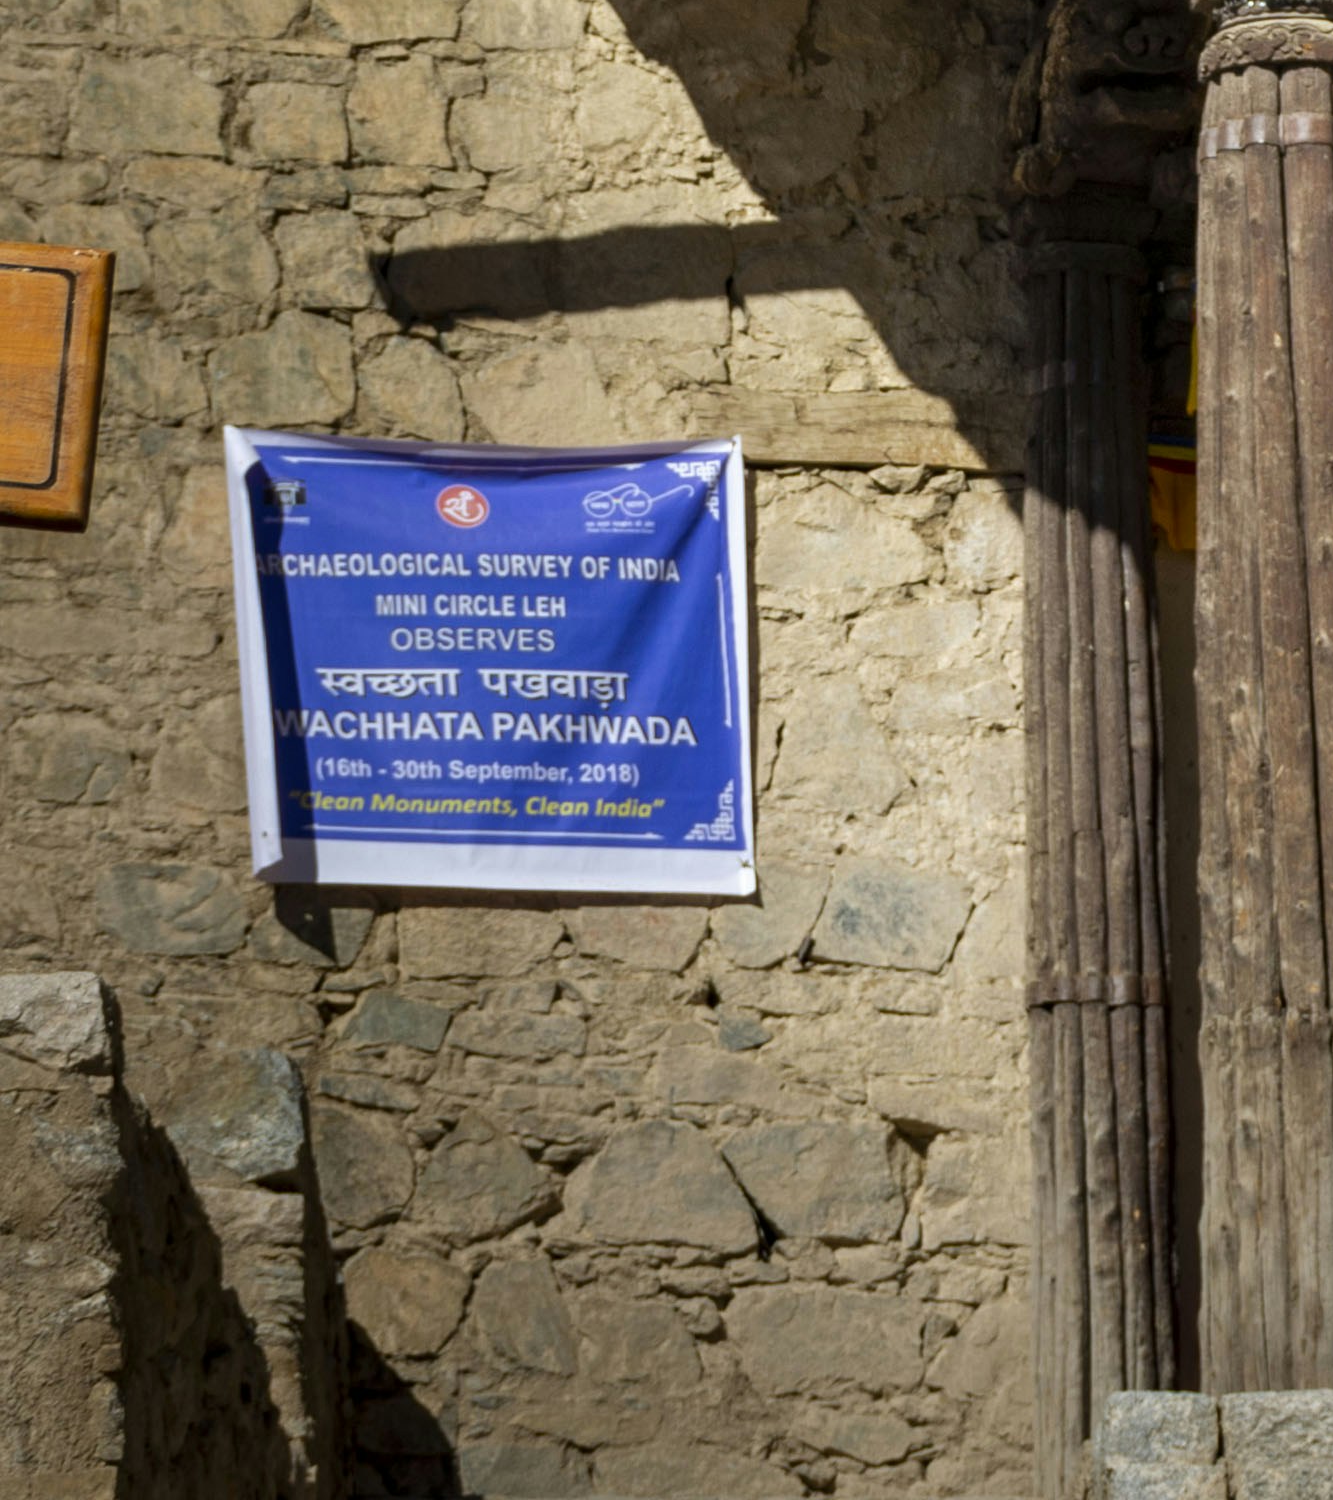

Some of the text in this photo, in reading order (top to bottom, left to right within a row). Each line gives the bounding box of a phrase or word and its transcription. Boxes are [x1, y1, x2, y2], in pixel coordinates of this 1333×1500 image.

[256, 553, 680, 582] ARCHAEOLOGICAL SURVEY OF INDIA
[376, 594, 567, 617] MINI CIRCLE LEH
[390, 627, 556, 652] OBSERVES
[315, 668, 630, 710] स्वच्छता पखवाड़ा
[274, 709, 698, 746] WACHHATA PAKHWADA
[315, 757, 372, 780] (16th
[392, 759, 442, 780] 30th
[449, 761, 574, 785] September,
[579, 764, 640, 787] 2018)
[370, 793, 519, 818] Monuments,
[525, 796, 589, 816] Clean
